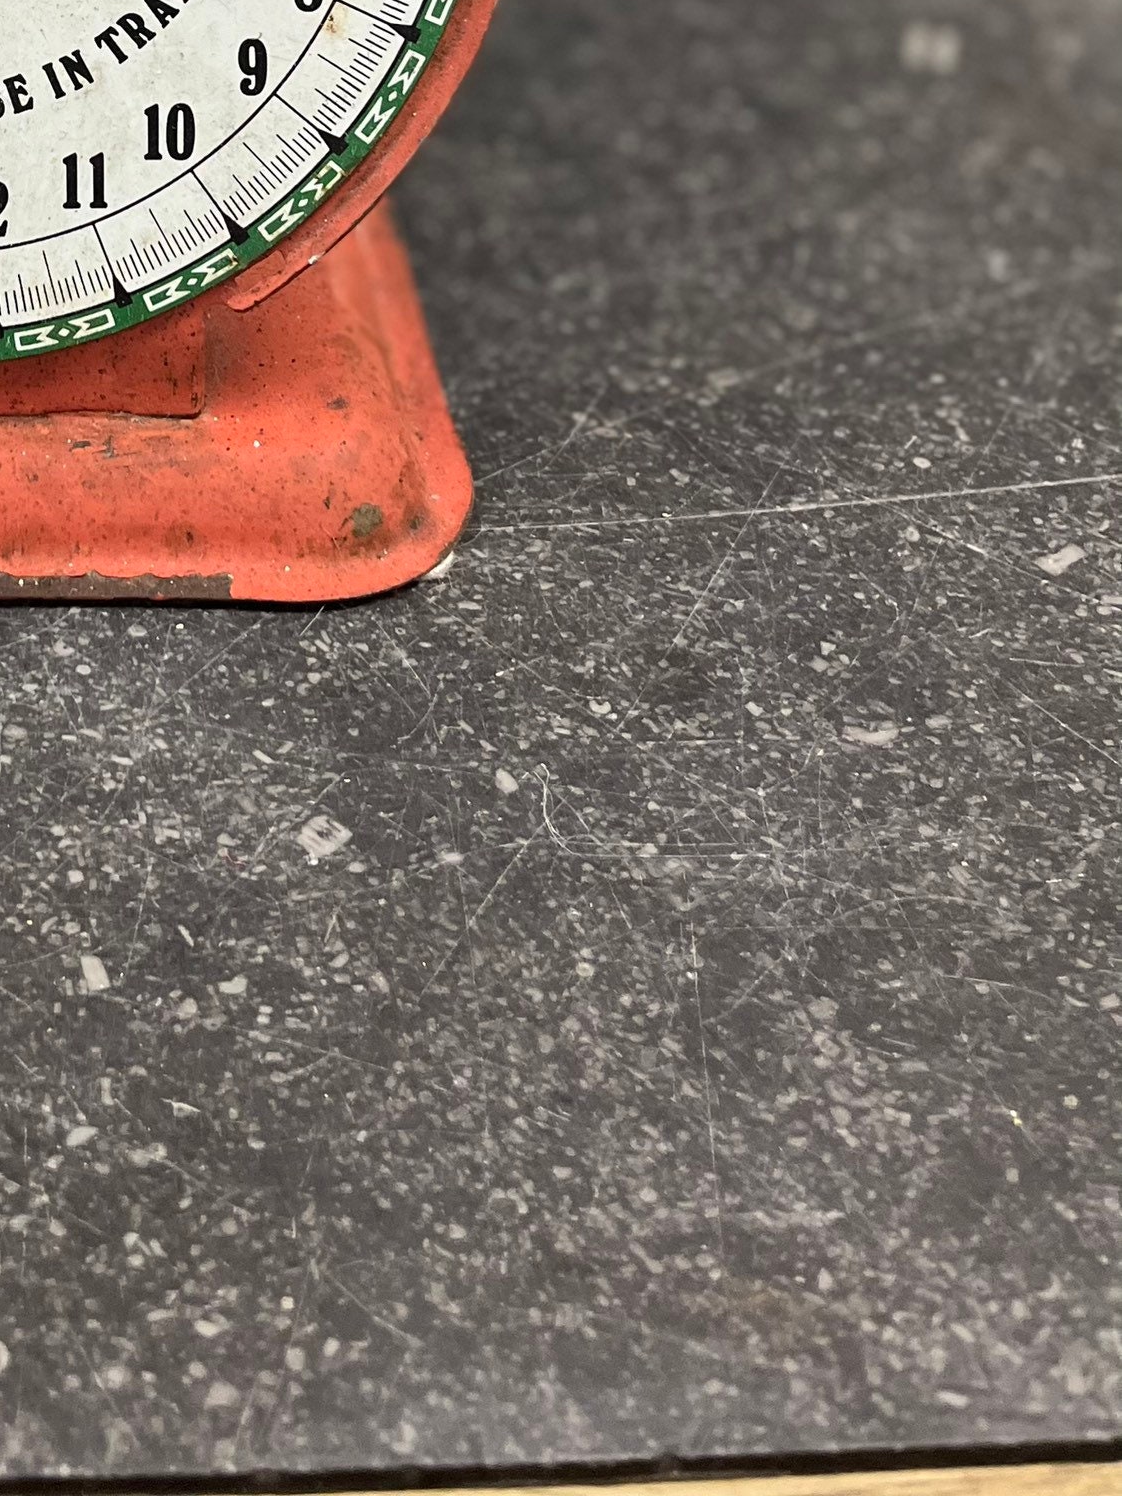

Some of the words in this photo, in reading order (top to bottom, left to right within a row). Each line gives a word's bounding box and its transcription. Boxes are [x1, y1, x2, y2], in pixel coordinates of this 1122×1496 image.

[42, 50, 94, 99] IN
[238, 39, 267, 97] 9
[144, 103, 195, 161] 10
[63, 152, 107, 209] 11
